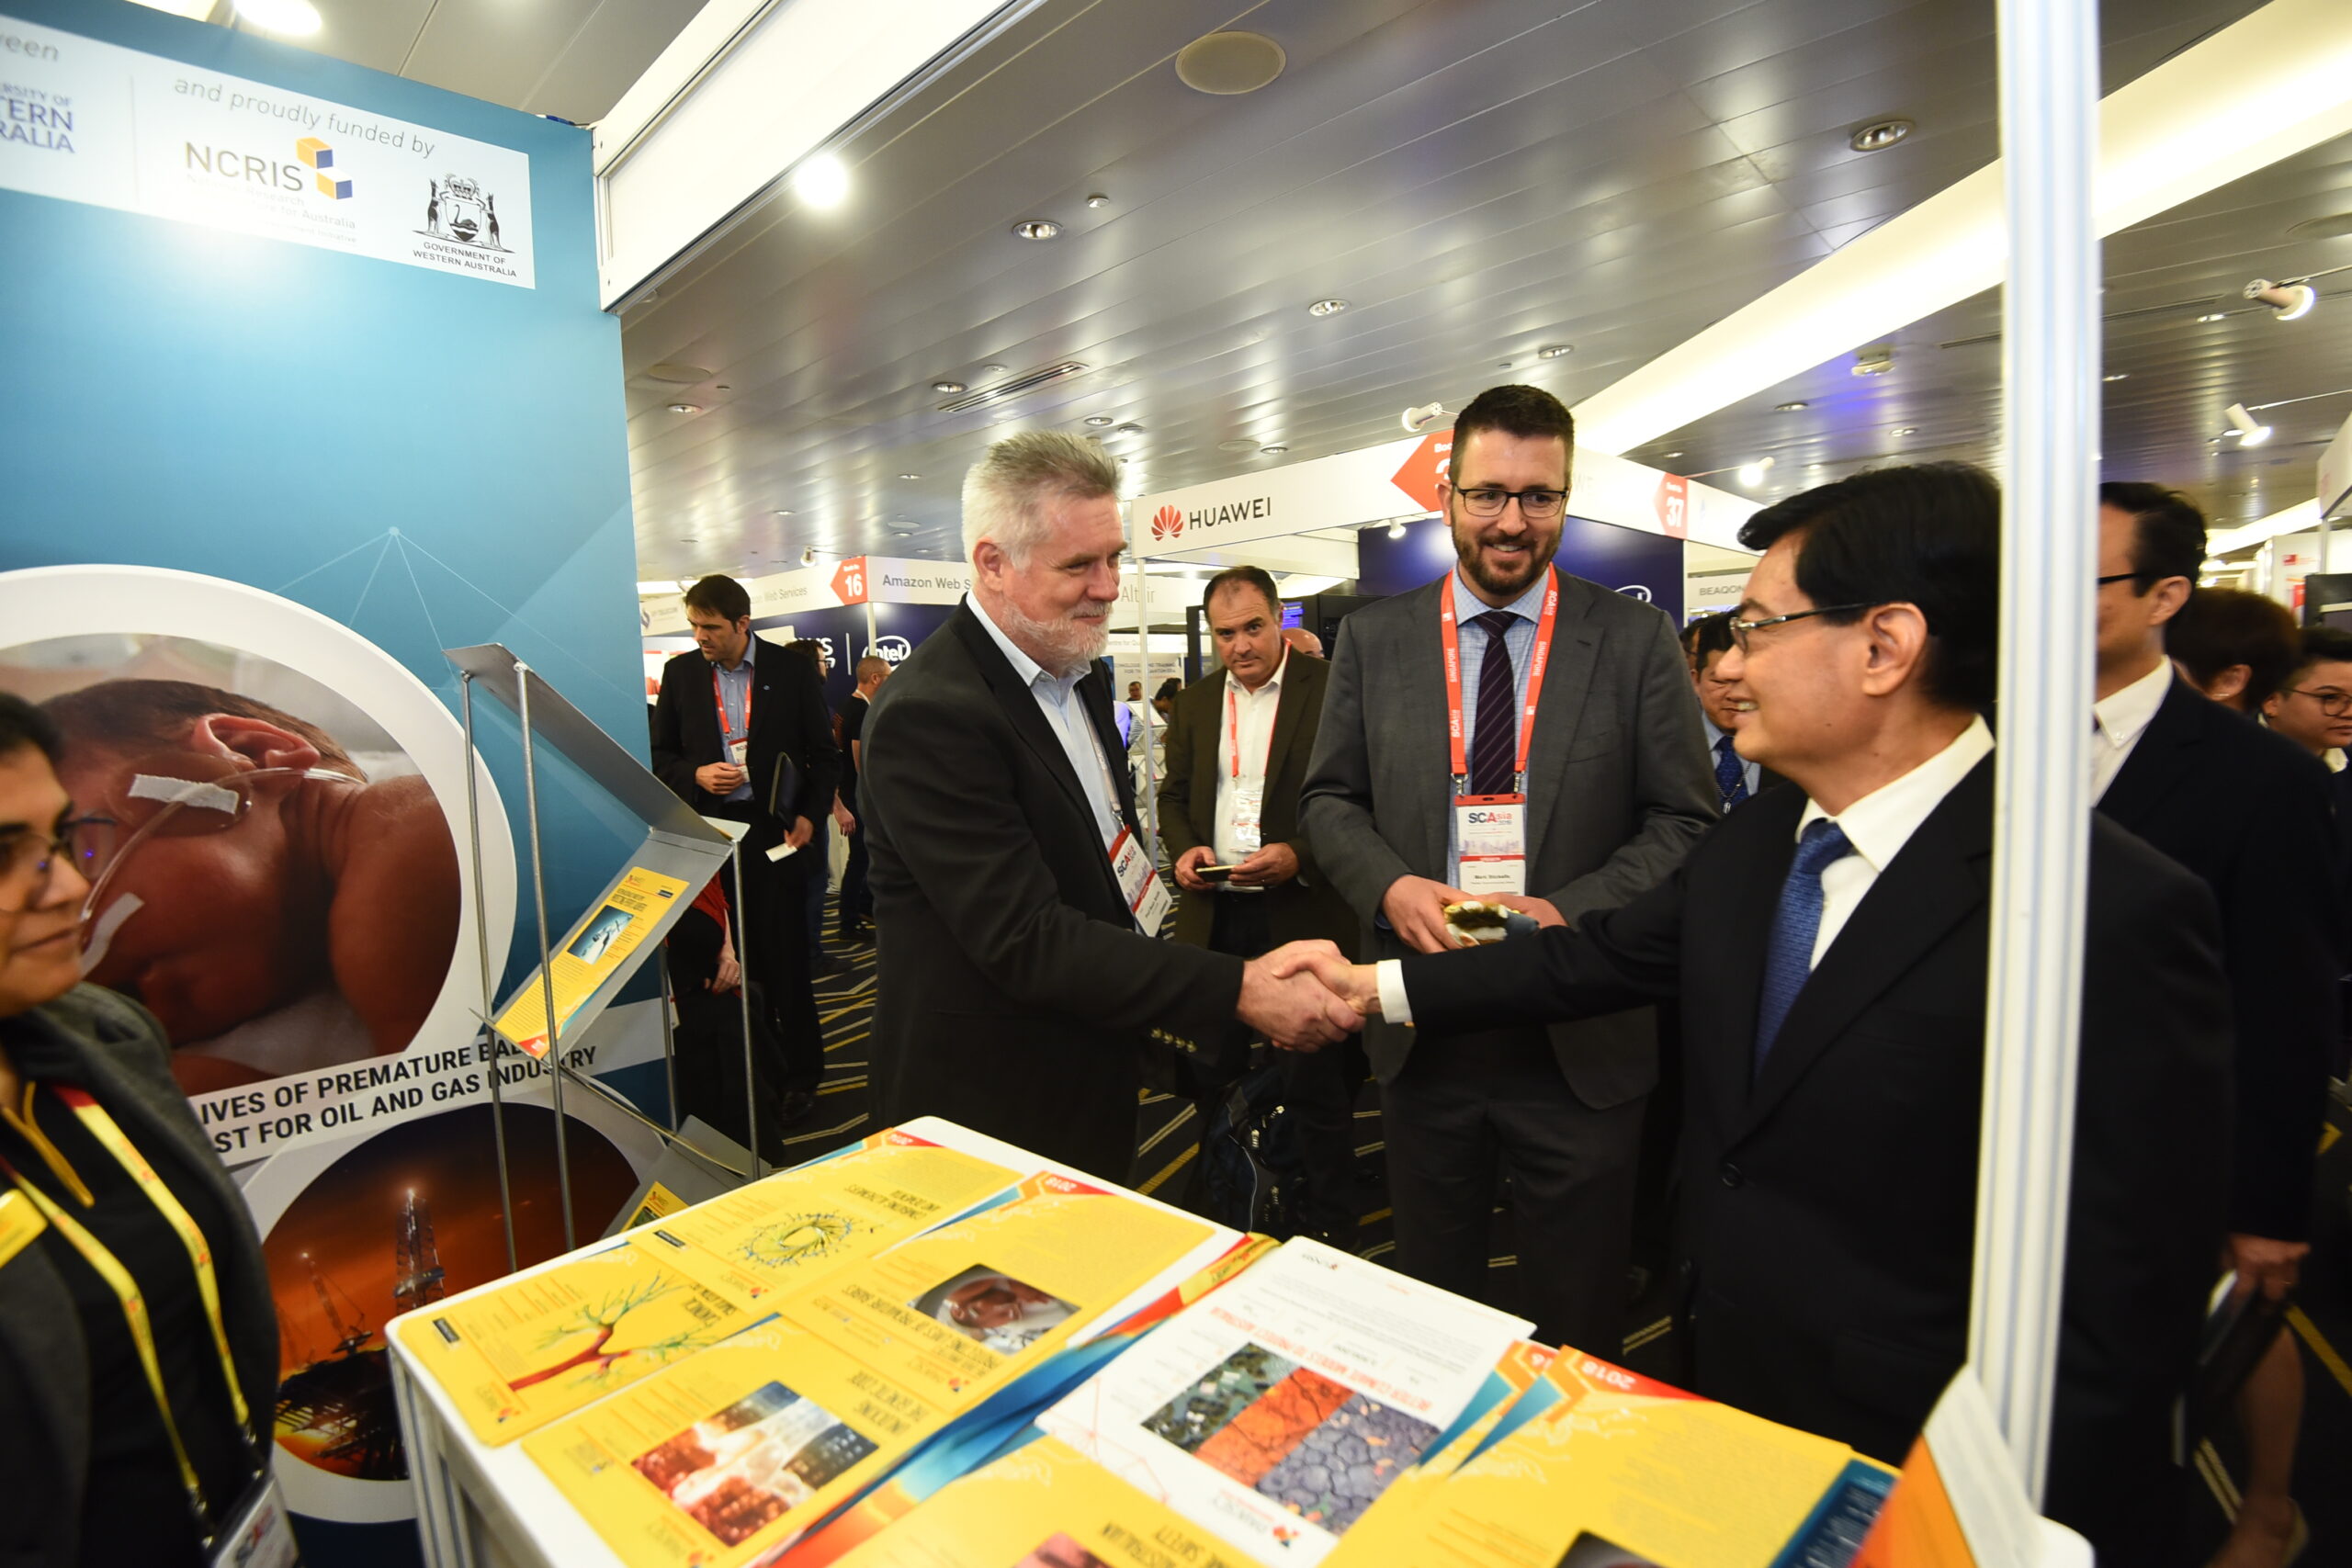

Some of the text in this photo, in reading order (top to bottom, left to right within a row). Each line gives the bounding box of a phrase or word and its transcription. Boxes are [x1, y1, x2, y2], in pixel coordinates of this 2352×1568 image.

[0, 34, 60, 62] een
[174, 77, 435, 159] and proudly funded by
[186, 141, 304, 192] NCRIS
[302, 209, 356, 231] Australia
[413, 248, 517, 277] WESTERN AUSTRALIA
[423, 241, 506, 265] GOVERNMENT OF
[1188, 496, 1272, 531] HUAWEI
[1666, 496, 1684, 528] 37
[844, 573, 864, 597] 16
[881, 574, 933, 589] Amazon
[935, 577, 961, 590] Web
[1120, 584, 1155, 604] Altir
[1447, 647, 1458, 683] SINGAPORE
[1468, 812, 1513, 824] SCAsia
[202, 1091, 266, 1125] IVES
[274, 1081, 309, 1109] OF
[317, 1045, 472, 1100] PREMATURE
[213, 1045, 597, 1154] ST FOR OIL AND GAS INDURY
[1581, 1360, 1636, 1391] 2018
